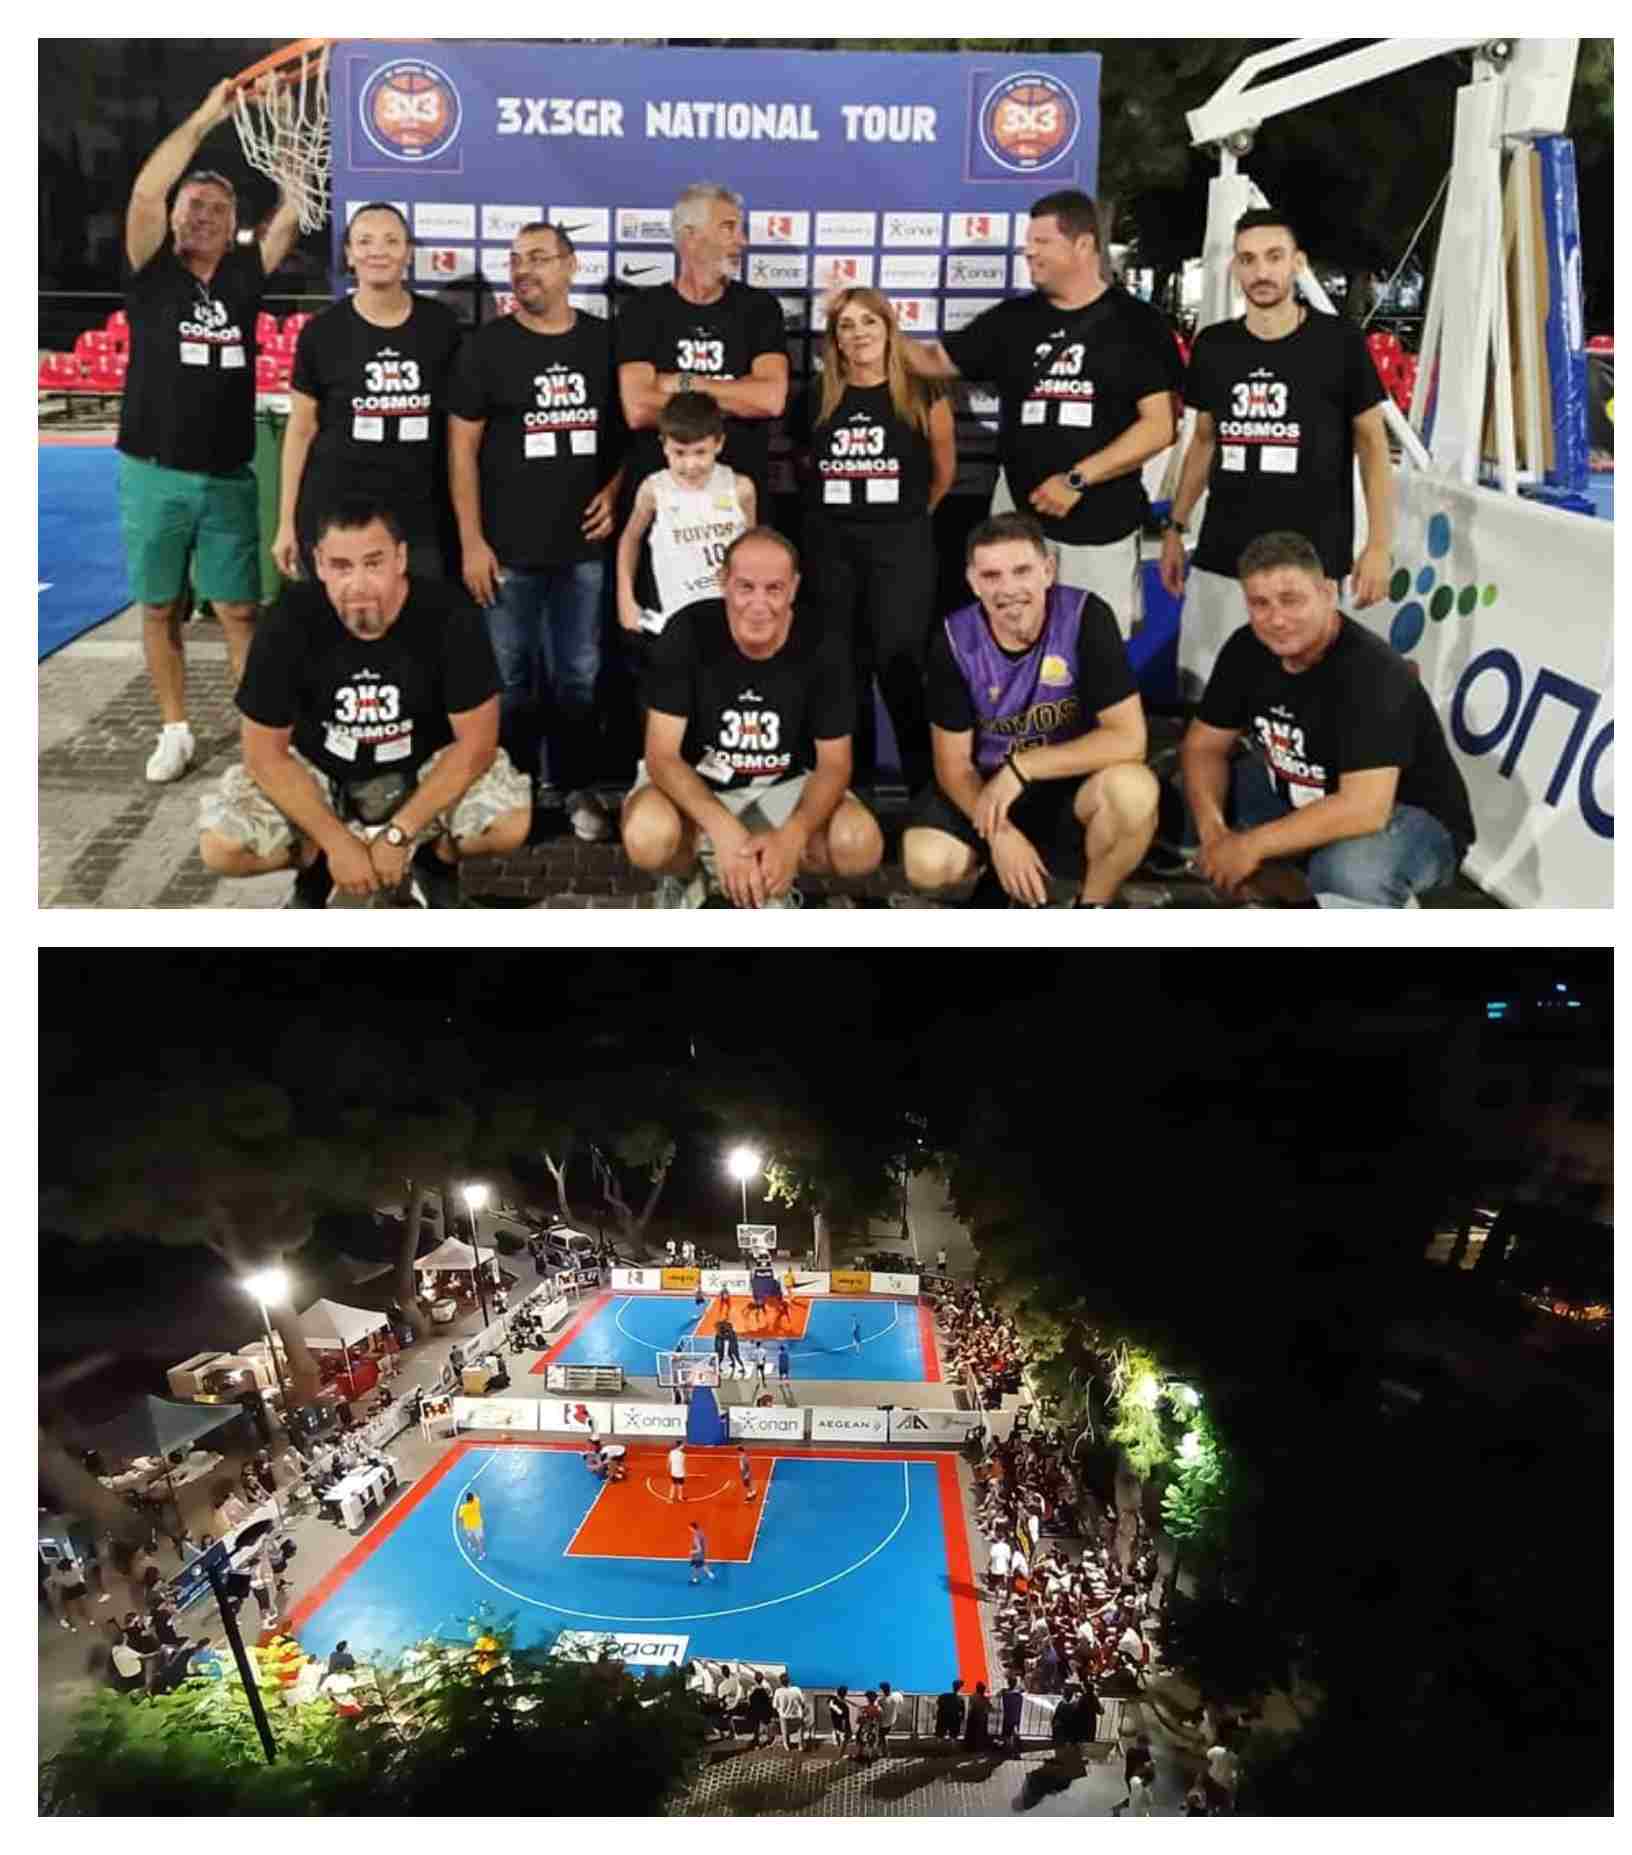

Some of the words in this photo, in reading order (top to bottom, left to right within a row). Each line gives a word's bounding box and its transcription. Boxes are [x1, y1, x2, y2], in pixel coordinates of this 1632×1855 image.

[496, 97, 624, 138] 3X3GR
[645, 100, 819, 142] NATIONAL
[841, 104, 937, 143] TOUR
[352, 395, 431, 410] COSMOS
[524, 409, 598, 426] COSMOS
[1220, 421, 1300, 438] COSMOS
[819, 459, 899, 472] COSMOS
[335, 685, 399, 722] 3X3
[720, 710, 780, 750] 3X3
[818, 1420, 870, 1430] AEGEAN
